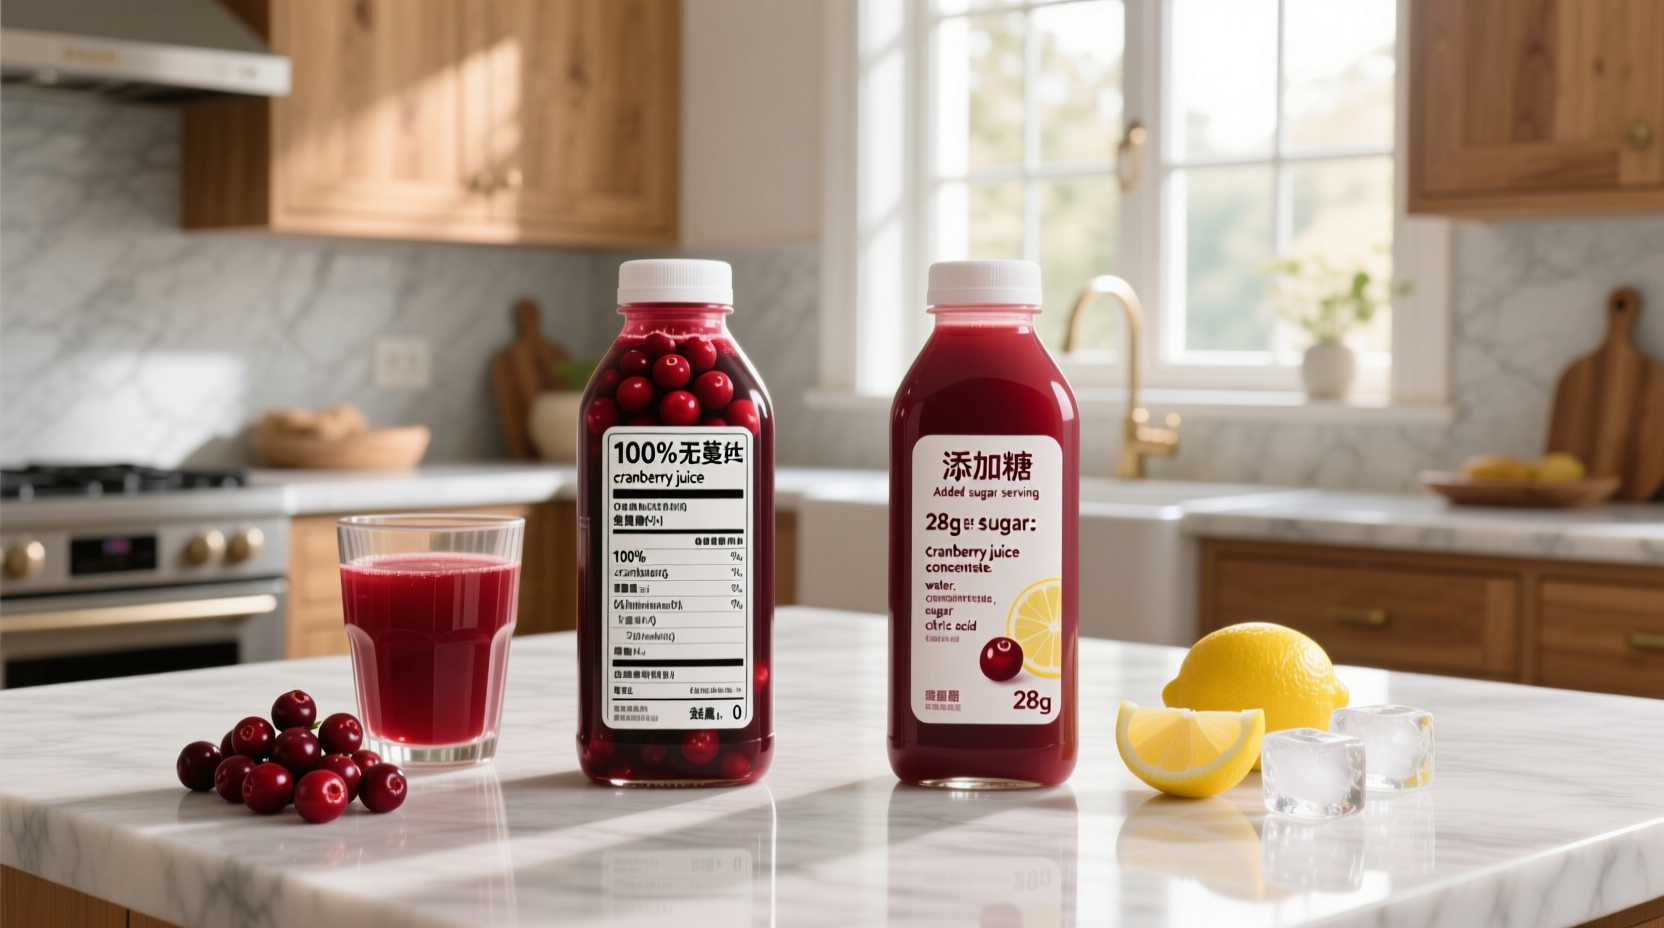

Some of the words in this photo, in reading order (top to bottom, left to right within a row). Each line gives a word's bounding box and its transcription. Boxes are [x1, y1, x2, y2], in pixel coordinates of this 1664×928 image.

[942, 450, 1034, 482] 添加糖
[613, 470, 673, 487] cranberry
[675, 470, 705, 487] juice
[933, 485, 965, 498] Added
[968, 489, 998, 501] sugar
[1001, 486, 1040, 501] serving
[613, 550, 647, 563] 100%
[988, 543, 1021, 561] juice
[1012, 689, 1052, 715] 28g
[732, 704, 742, 720] 0
